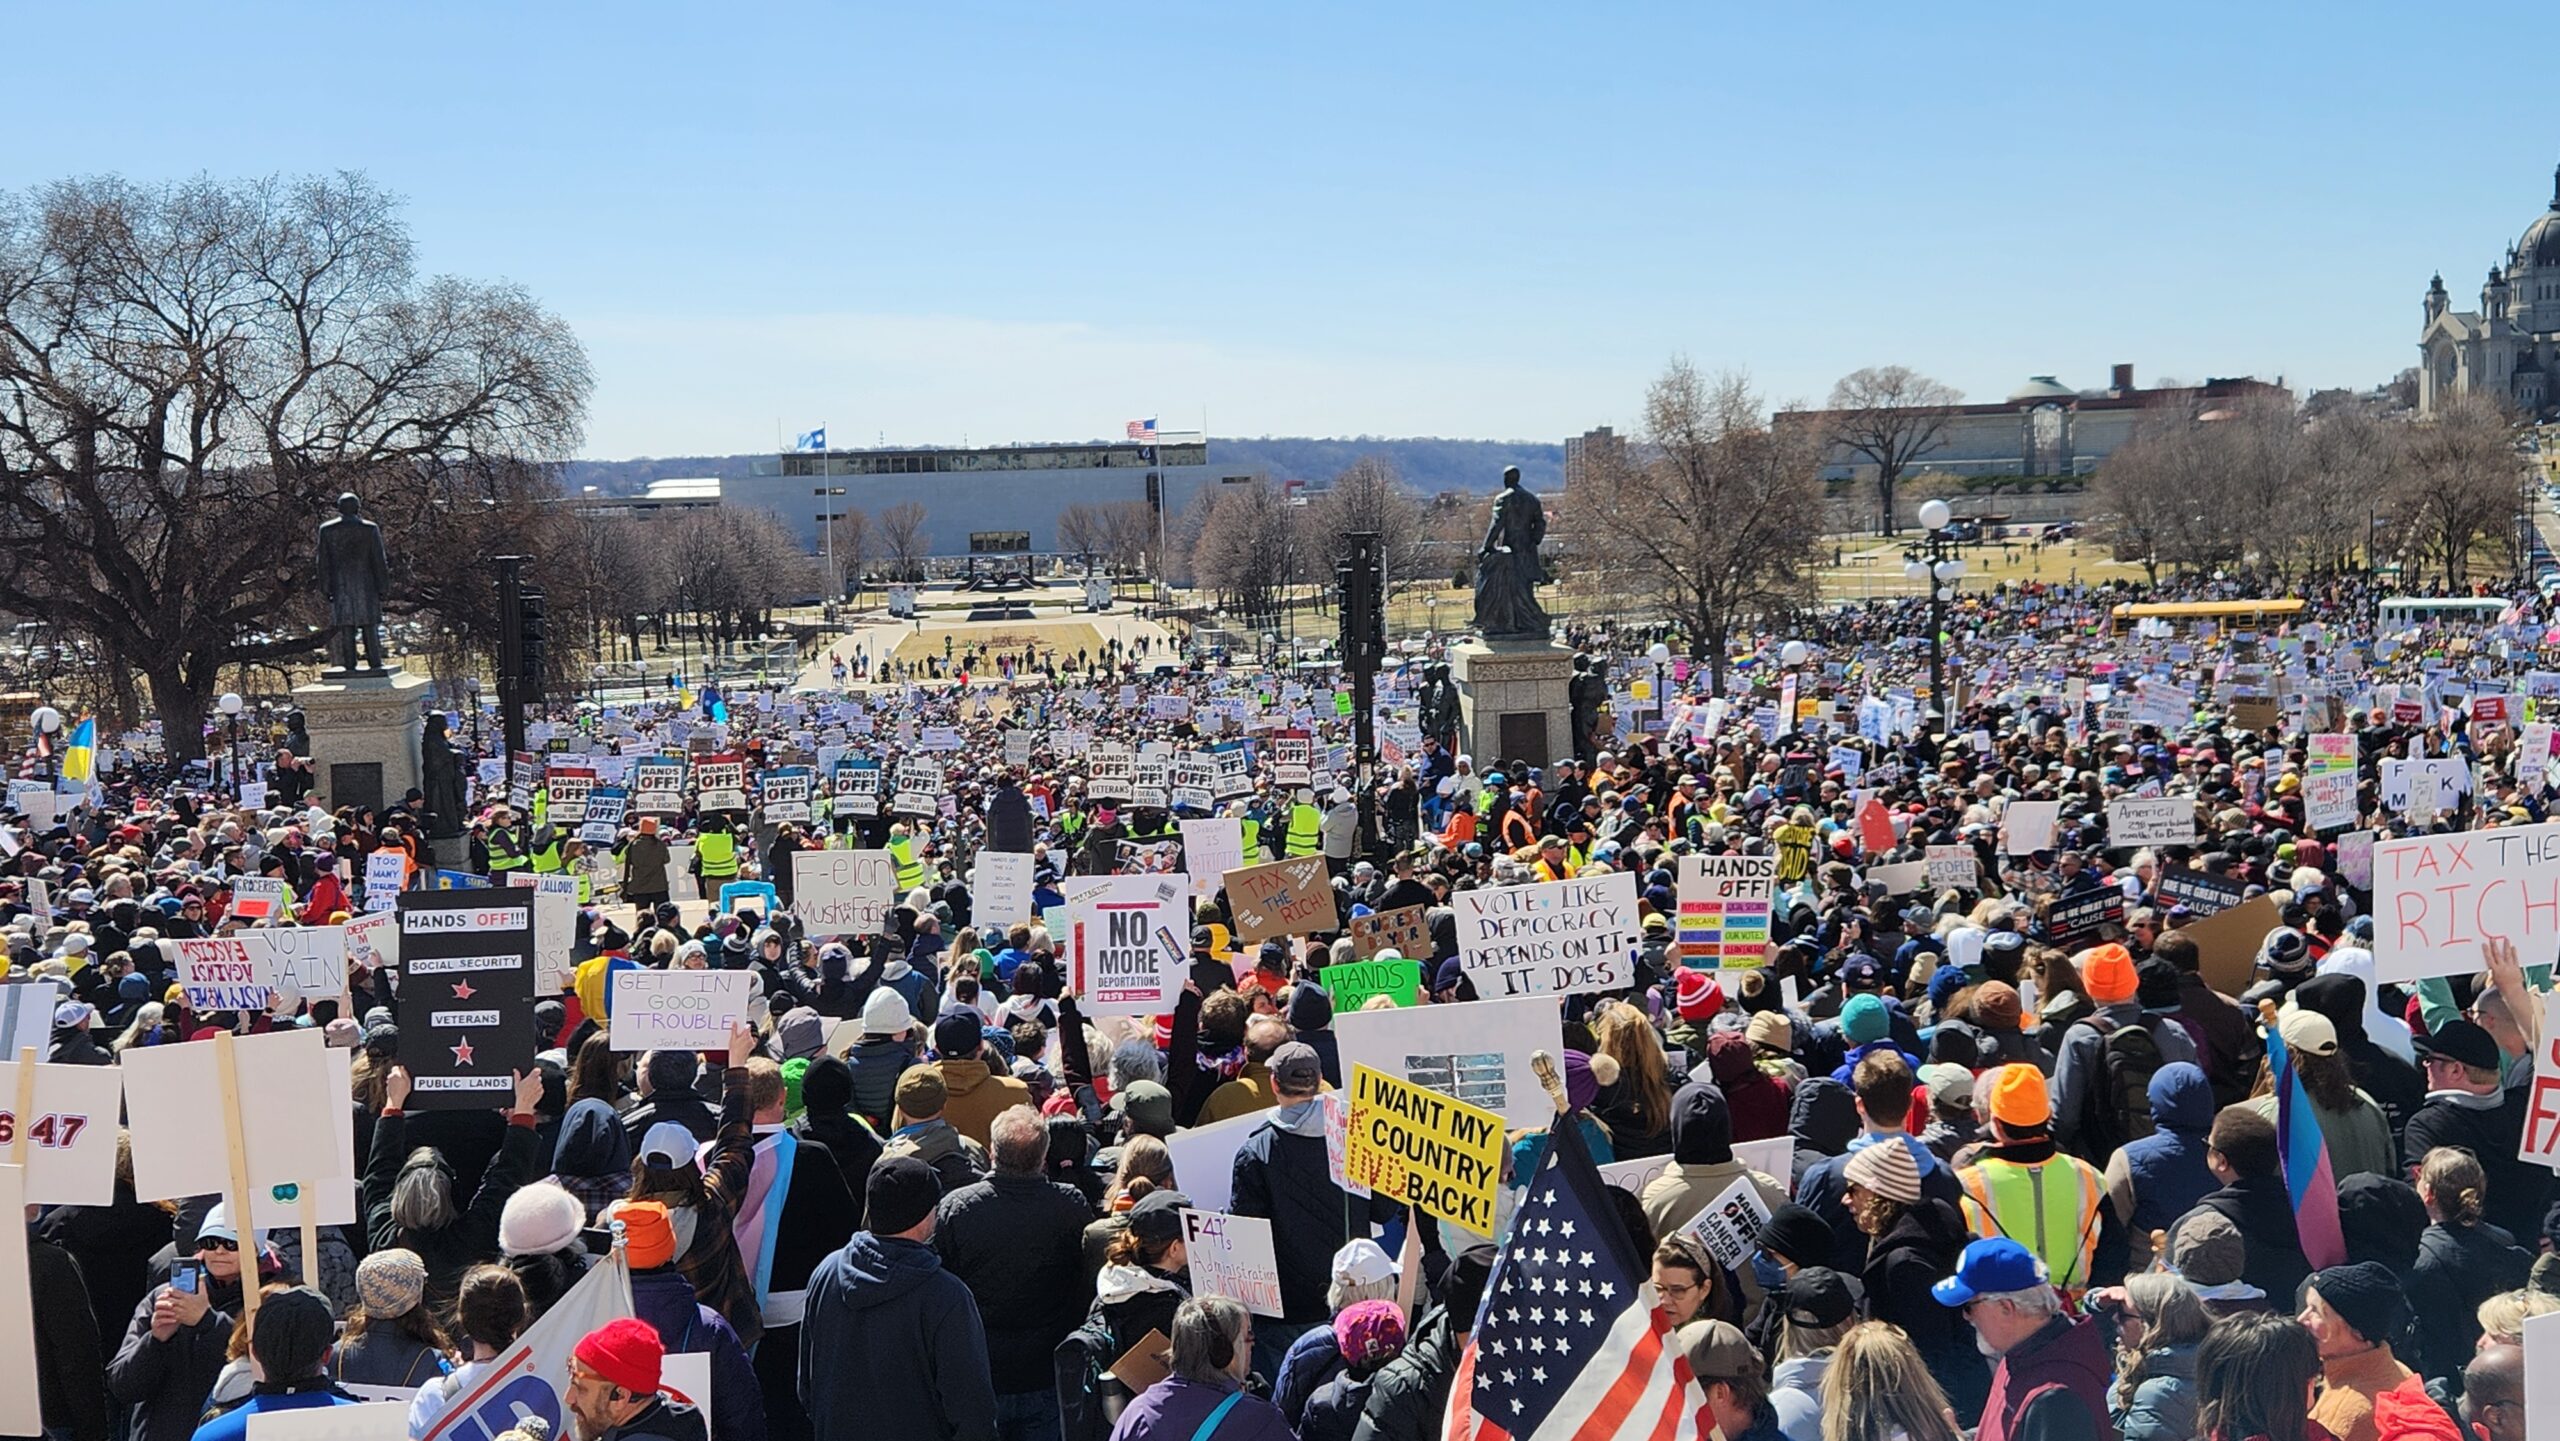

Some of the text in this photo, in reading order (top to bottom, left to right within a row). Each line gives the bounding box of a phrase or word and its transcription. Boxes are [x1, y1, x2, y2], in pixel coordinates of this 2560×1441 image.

[1278, 740, 1308, 748] HANDS
[1092, 754, 1130, 762] HANDS
[1221, 751, 1242, 761] NDS
[1277, 749, 1308, 761] OFF!
[641, 767, 680, 775] HANDS
[700, 764, 740, 774] HANDS
[839, 770, 877, 779] HANDS
[902, 767, 938, 779] HANDS
[1092, 762, 1130, 776] OFF!
[1178, 763, 1215, 773] HANDS
[1220, 760, 1244, 774] FF!
[2394, 764, 2404, 777] F
[551, 778, 591, 787] HANDS
[640, 776, 680, 789] OFF!
[701, 774, 740, 788] OFF!
[766, 778, 806, 787] HANDS
[1138, 773, 1163, 785] FF!
[1177, 771, 1213, 786] OFF!
[1278, 771, 1308, 779] EDUCATION
[2339, 774, 2354, 787] THE
[838, 779, 876, 792] OFF!
[901, 777, 937, 793] OFF!
[1091, 785, 1130, 794] VETERANS
[2441, 777, 2454, 790] K
[652, 794, 666, 802] OUR
[767, 787, 806, 801] OFF!
[2392, 793, 2406, 806] M
[591, 798, 622, 808] HANDS
[638, 801, 681, 809] CIVIL RIGHTS
[711, 799, 735, 807] BODIES
[836, 801, 876, 809] IMMIGRANTS
[588, 806, 621, 820] OFF!
[767, 810, 808, 820] PUBLIC LANDS
[2119, 804, 2174, 819] America
[1206, 836, 1220, 846] IS
[375, 856, 398, 866] TOO
[2382, 834, 2560, 880] TAX THE
[373, 869, 399, 879] MANY
[1701, 859, 1774, 877] HANDS
[1928, 860, 1974, 875] PEOPLE
[236, 878, 283, 893] GROCERIES
[540, 879, 574, 894] CALLOUS
[1242, 867, 1288, 898] TAX
[1718, 880, 1771, 899] OFF!
[1263, 888, 1293, 912] THE
[1470, 882, 1613, 914] VOTE LIKE
[2162, 879, 2240, 906] ARE WE GREAT YET?
[371, 901, 393, 910] LIST
[796, 897, 842, 925] Musk
[1280, 892, 1328, 924] RICH!
[2067, 908, 2079, 917] WE
[2080, 901, 2104, 914] GREAT
[407, 914, 467, 929] HANDS
[476, 912, 526, 927] OFF!!!
[2396, 877, 2560, 950] RICH
[347, 918, 386, 935] DEPORT
[1109, 911, 1148, 947] NO
[1353, 907, 1426, 938] CONGRESS!
[1477, 906, 1619, 940] DEMOCRACY
[1388, 929, 1419, 945] YOUR
[1725, 931, 1739, 940] OUR
[1740, 931, 1765, 940] VOTES
[179, 940, 249, 962] FASCISM
[1466, 941, 1554, 970] DEPENDS
[1563, 938, 1589, 959] ON
[411, 956, 518, 972] SOCIAL SECURITY
[1099, 949, 1158, 974] MORE
[191, 963, 254, 984] AGAINST
[1329, 963, 1405, 991] HANDS
[618, 973, 732, 993] GET IN
[1098, 976, 1160, 987] DEPORTATIONS
[1501, 968, 1535, 995] IT
[648, 994, 711, 1011] GOOD
[435, 1014, 498, 1025] VETERANS
[627, 1012, 737, 1030] TROUBLE
[684, 1038, 717, 1047] Lewis
[418, 1078, 508, 1089] PUBLIC LANDS
[1359, 1072, 1495, 1150] I WANT MY
[28, 1113, 88, 1149] 47
[1372, 1118, 1494, 1191] COUNTRY
[1407, 1171, 1491, 1229] BACK!
[1720, 1202, 1758, 1245] OFF!
[1705, 1212, 1742, 1260] CANCER
[1697, 1221, 1732, 1267] RESEARCH
[1193, 1249, 1277, 1281] Administration
[1201, 1274, 1281, 1312] is DESTRUCTIVE
